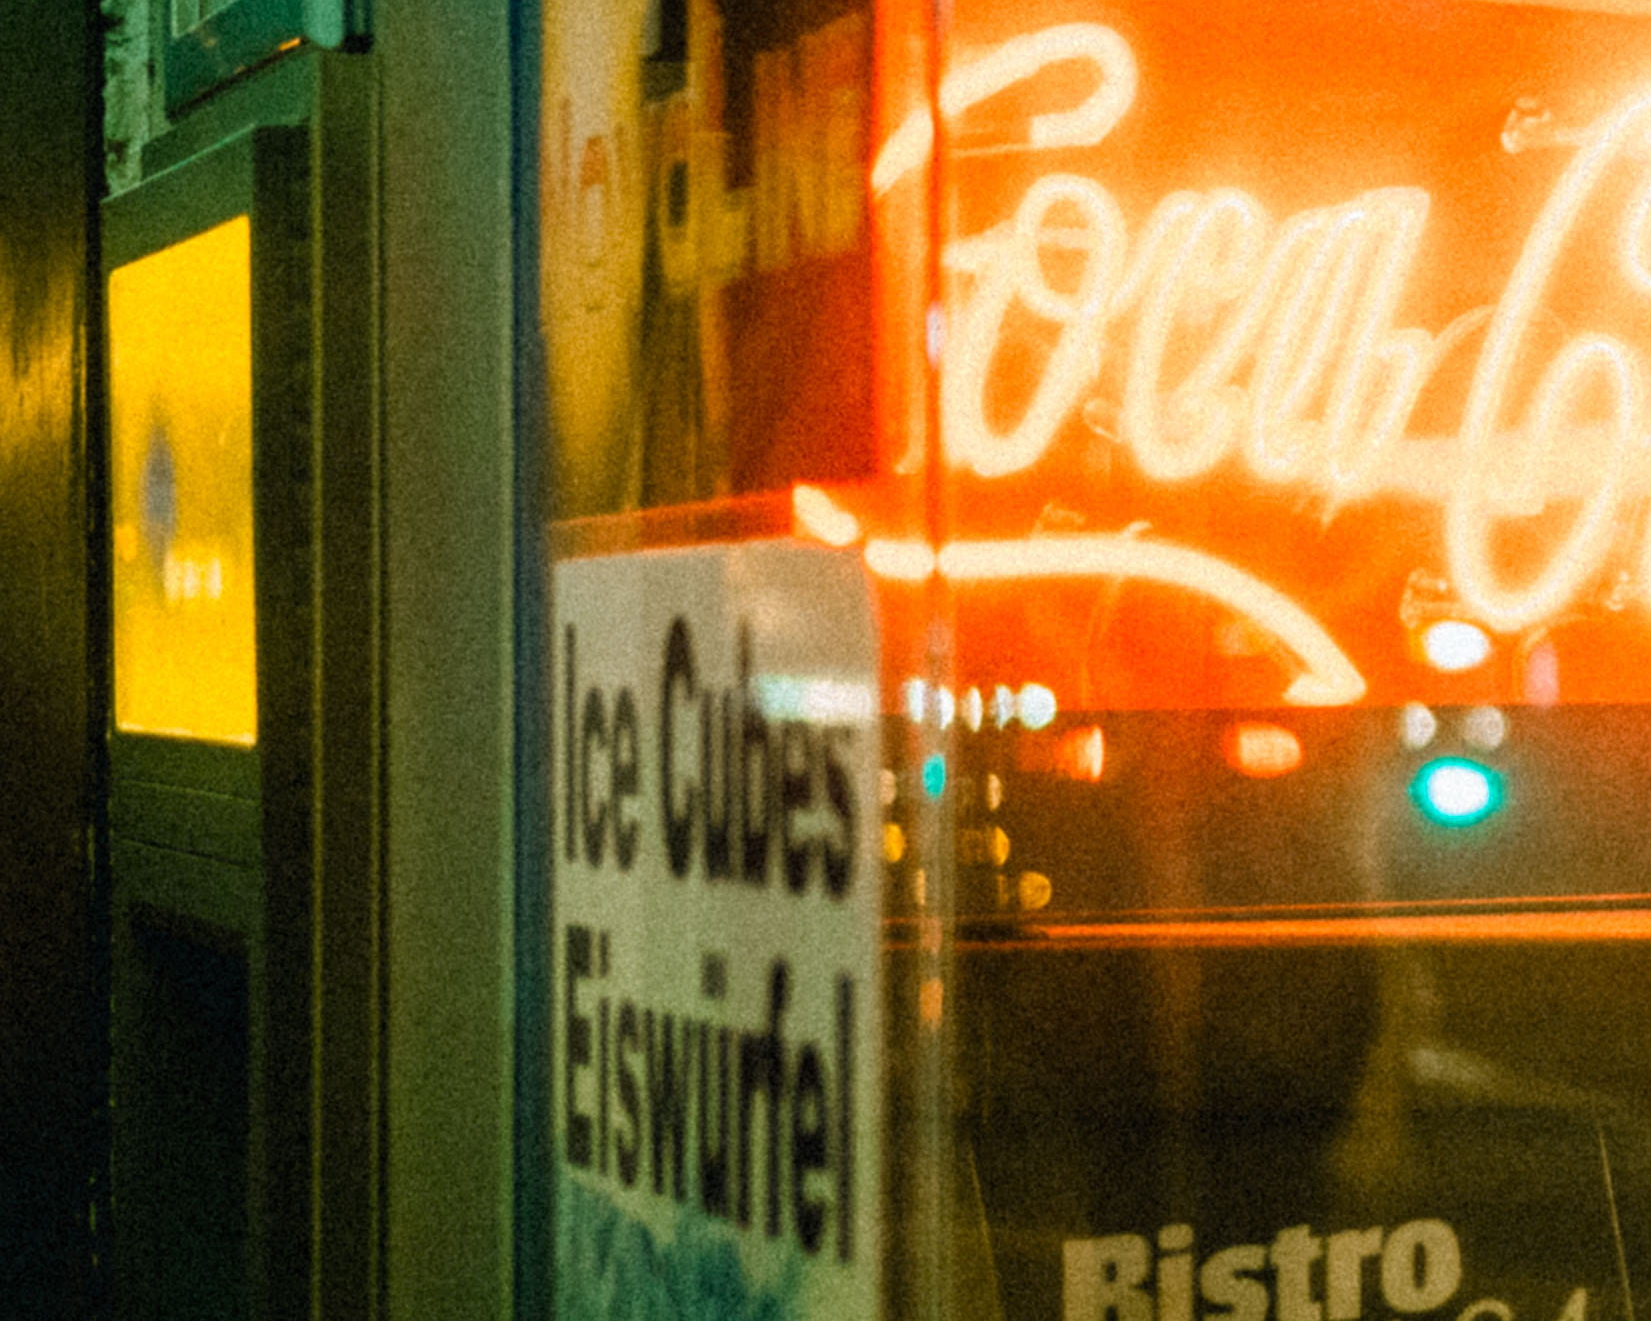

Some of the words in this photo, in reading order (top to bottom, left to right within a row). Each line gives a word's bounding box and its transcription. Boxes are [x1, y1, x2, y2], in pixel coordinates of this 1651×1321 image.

[563, 621, 641, 877] Ice
[661, 614, 860, 905] Cubes
[563, 923, 857, 1265] Eiswürfel
